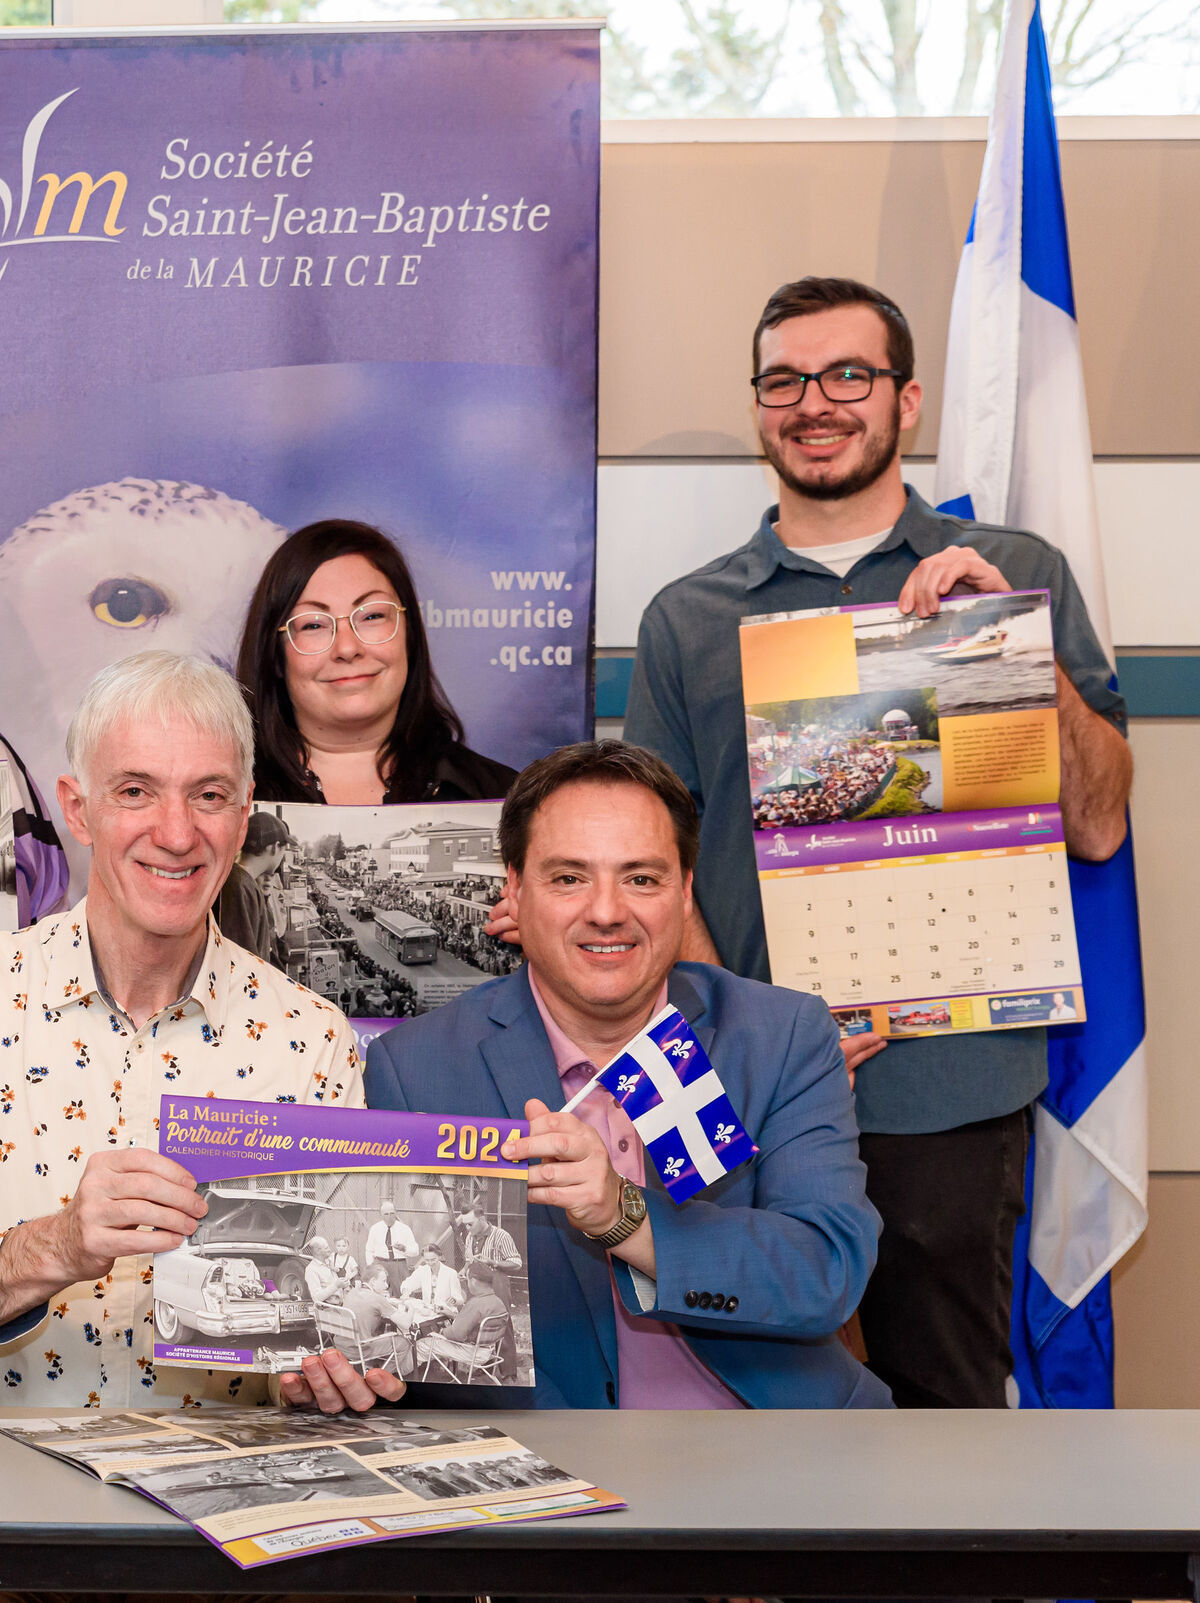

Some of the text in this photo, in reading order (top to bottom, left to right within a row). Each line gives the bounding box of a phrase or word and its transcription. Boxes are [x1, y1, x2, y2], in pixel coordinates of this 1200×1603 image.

[160, 139, 313, 180] Société
[142, 192, 551, 248] Saint-Jean-Baptiste
[126, 255, 423, 289] de la MAURICIE
[490, 571, 573, 591] www.
[490, 645, 572, 673] .qc.ca
[883, 824, 938, 847] Juin
[807, 903, 812, 911] 2
[847, 900, 853, 908] 3
[928, 892, 934, 900] 5
[808, 907, 1058, 938] 9 10 11 12 13 14 15
[809, 956, 818, 964] 16
[850, 952, 858, 960] 17
[888, 948, 898, 956] 18
[968, 942, 979, 950] 20
[1011, 937, 1020, 945] 21
[1050, 934, 1061, 942] 22
[812, 960, 1064, 990] 23 24 25 26 27 28 29
[168, 1103, 188, 1121] La
[193, 1105, 269, 1126] Mauricie
[165, 1145, 275, 1161] CALENDRIER HISTORIQUE
[166, 1121, 411, 1159] Portrait d'une communauté
[174, 1347, 211, 1355] APPARTENANCE
